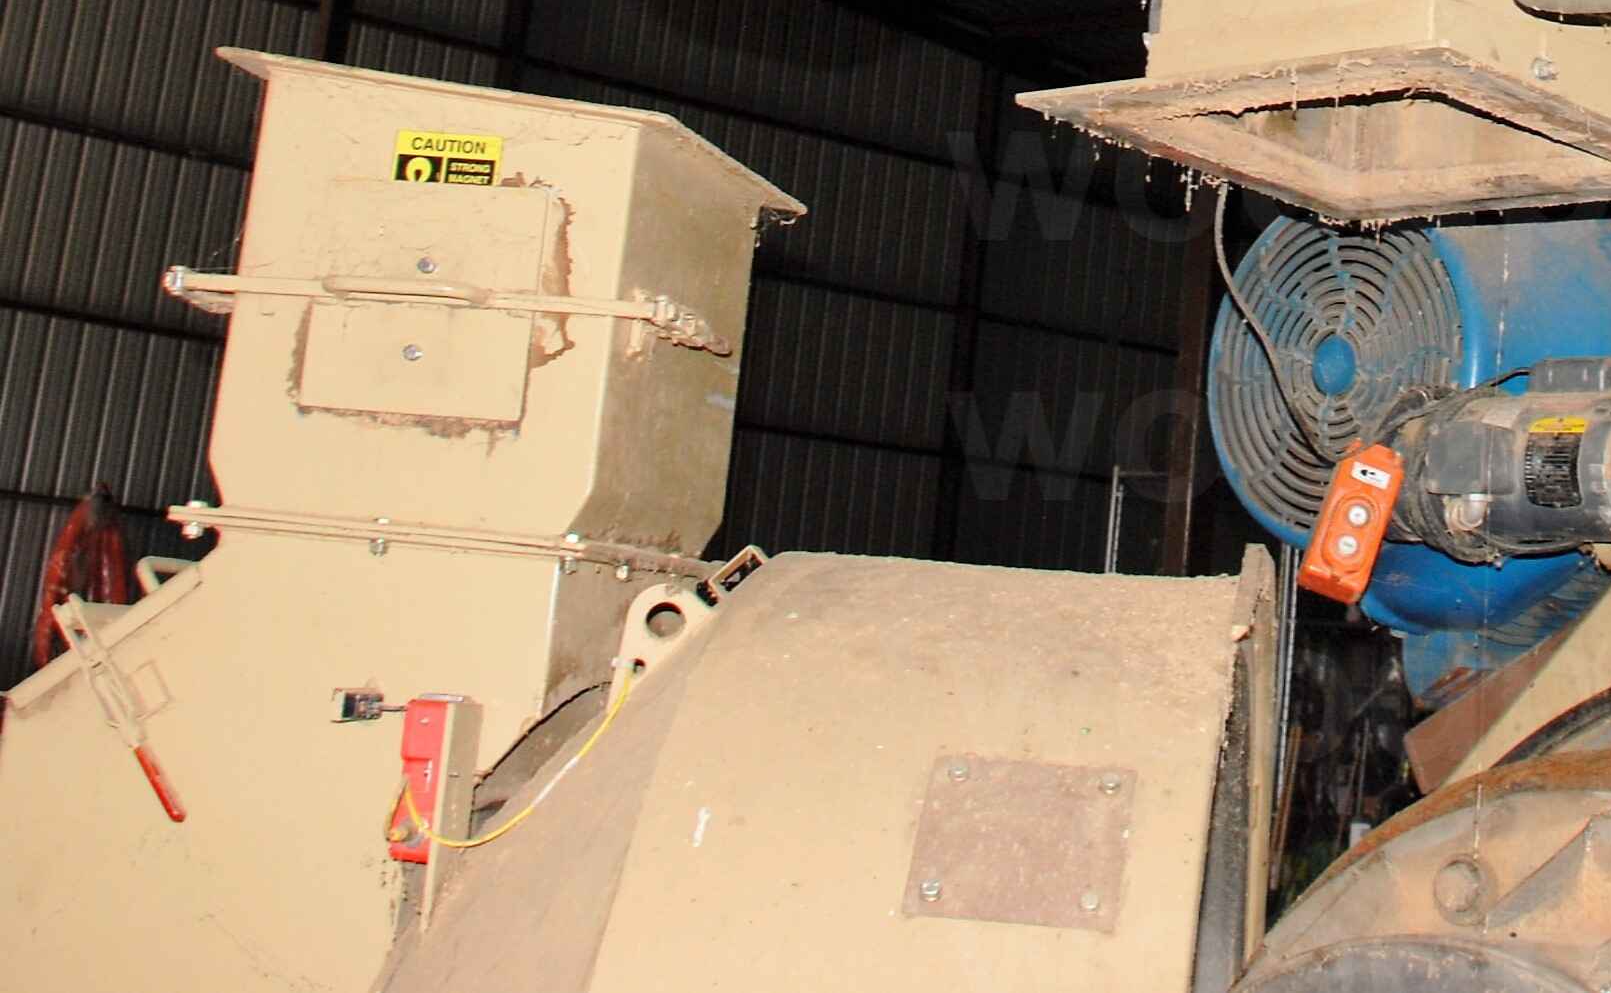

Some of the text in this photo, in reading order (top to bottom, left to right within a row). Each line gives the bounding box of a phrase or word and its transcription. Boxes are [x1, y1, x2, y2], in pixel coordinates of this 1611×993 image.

[411, 136, 487, 155] CAUTION
[448, 161, 491, 174] STRONG
[447, 173, 491, 185] MAGNET
